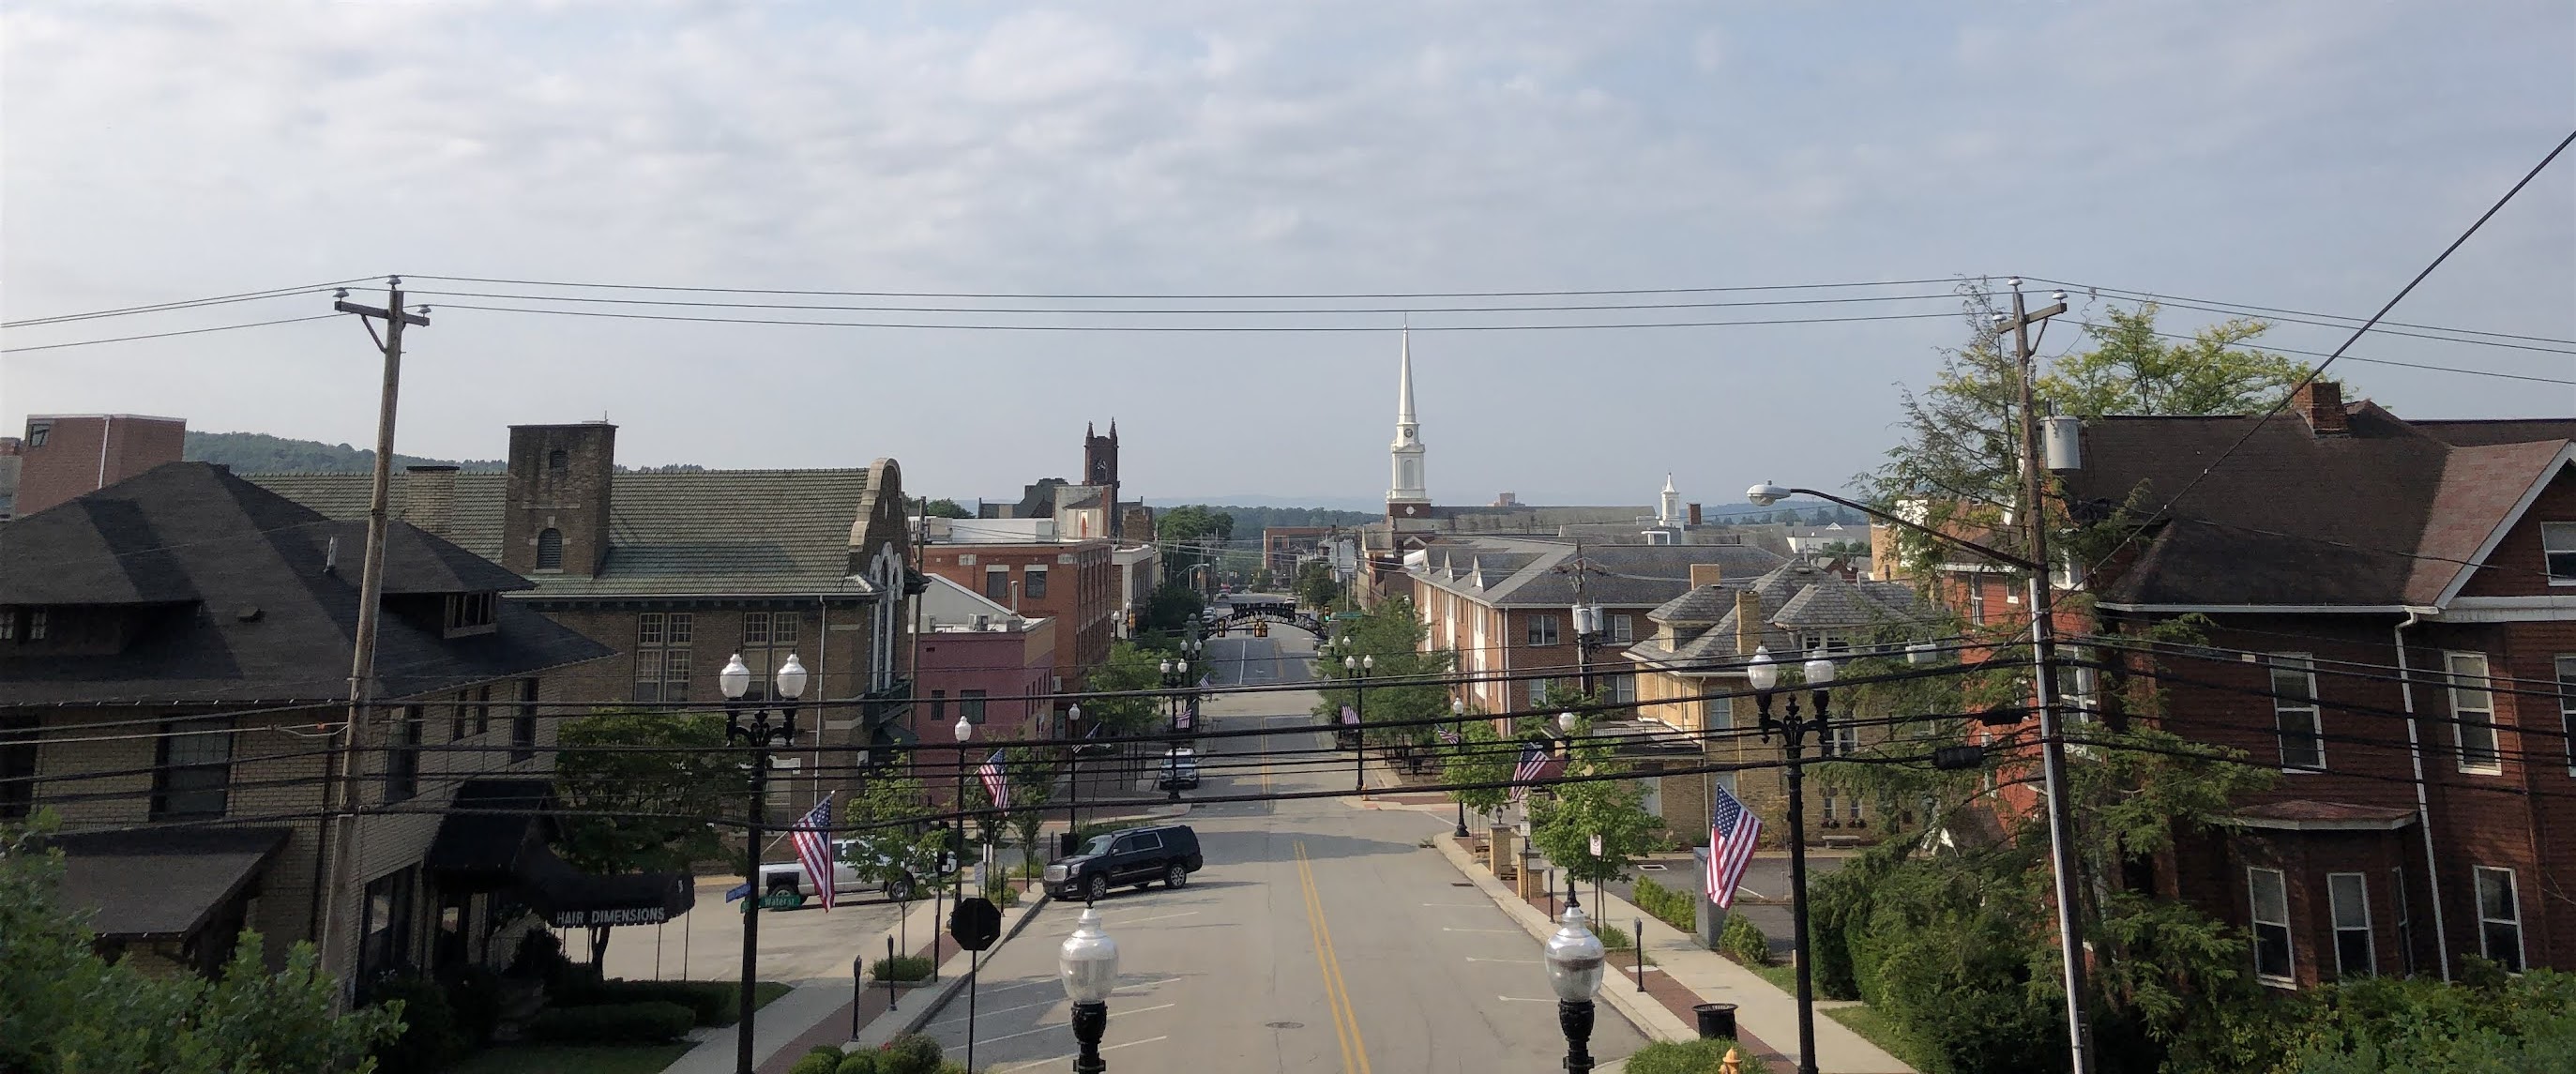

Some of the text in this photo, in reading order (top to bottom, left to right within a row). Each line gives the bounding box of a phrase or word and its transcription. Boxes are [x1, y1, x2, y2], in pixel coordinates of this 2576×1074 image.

[765, 897, 787, 907] Water
[556, 907, 665, 925] HAIR DIMENSIONS
